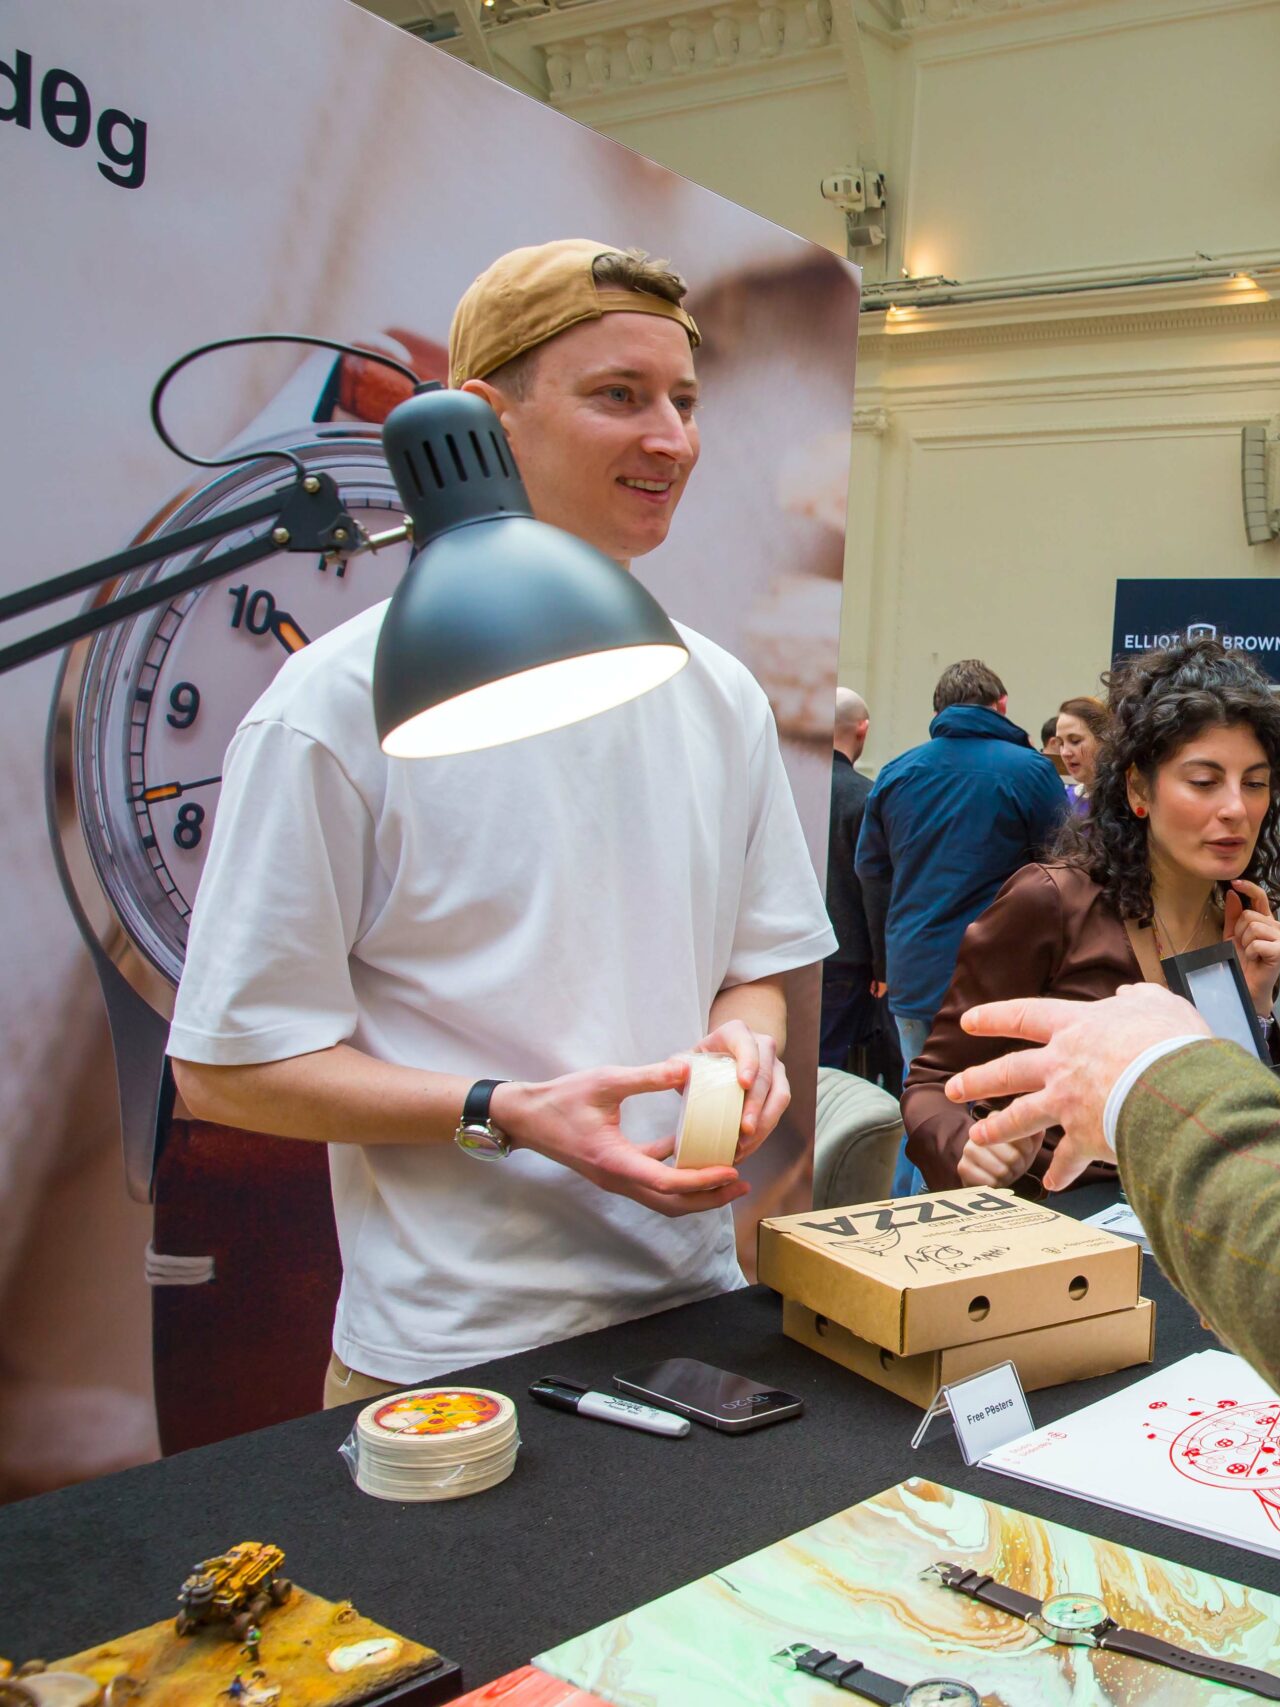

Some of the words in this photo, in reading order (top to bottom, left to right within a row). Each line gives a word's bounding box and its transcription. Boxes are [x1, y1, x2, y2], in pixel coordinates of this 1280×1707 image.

[228, 584, 276, 636] 10
[1124, 634, 1180, 649] ELLIOT
[166, 682, 200, 729] 9
[173, 802, 206, 850] 8
[797, 1192, 1018, 1237] PIZZA
[995, 1207, 1027, 1217] HAND
[928, 1213, 994, 1228] DELIVERED
[721, 1395, 769, 1410] 10:20
[966, 1413, 985, 1425] Free
